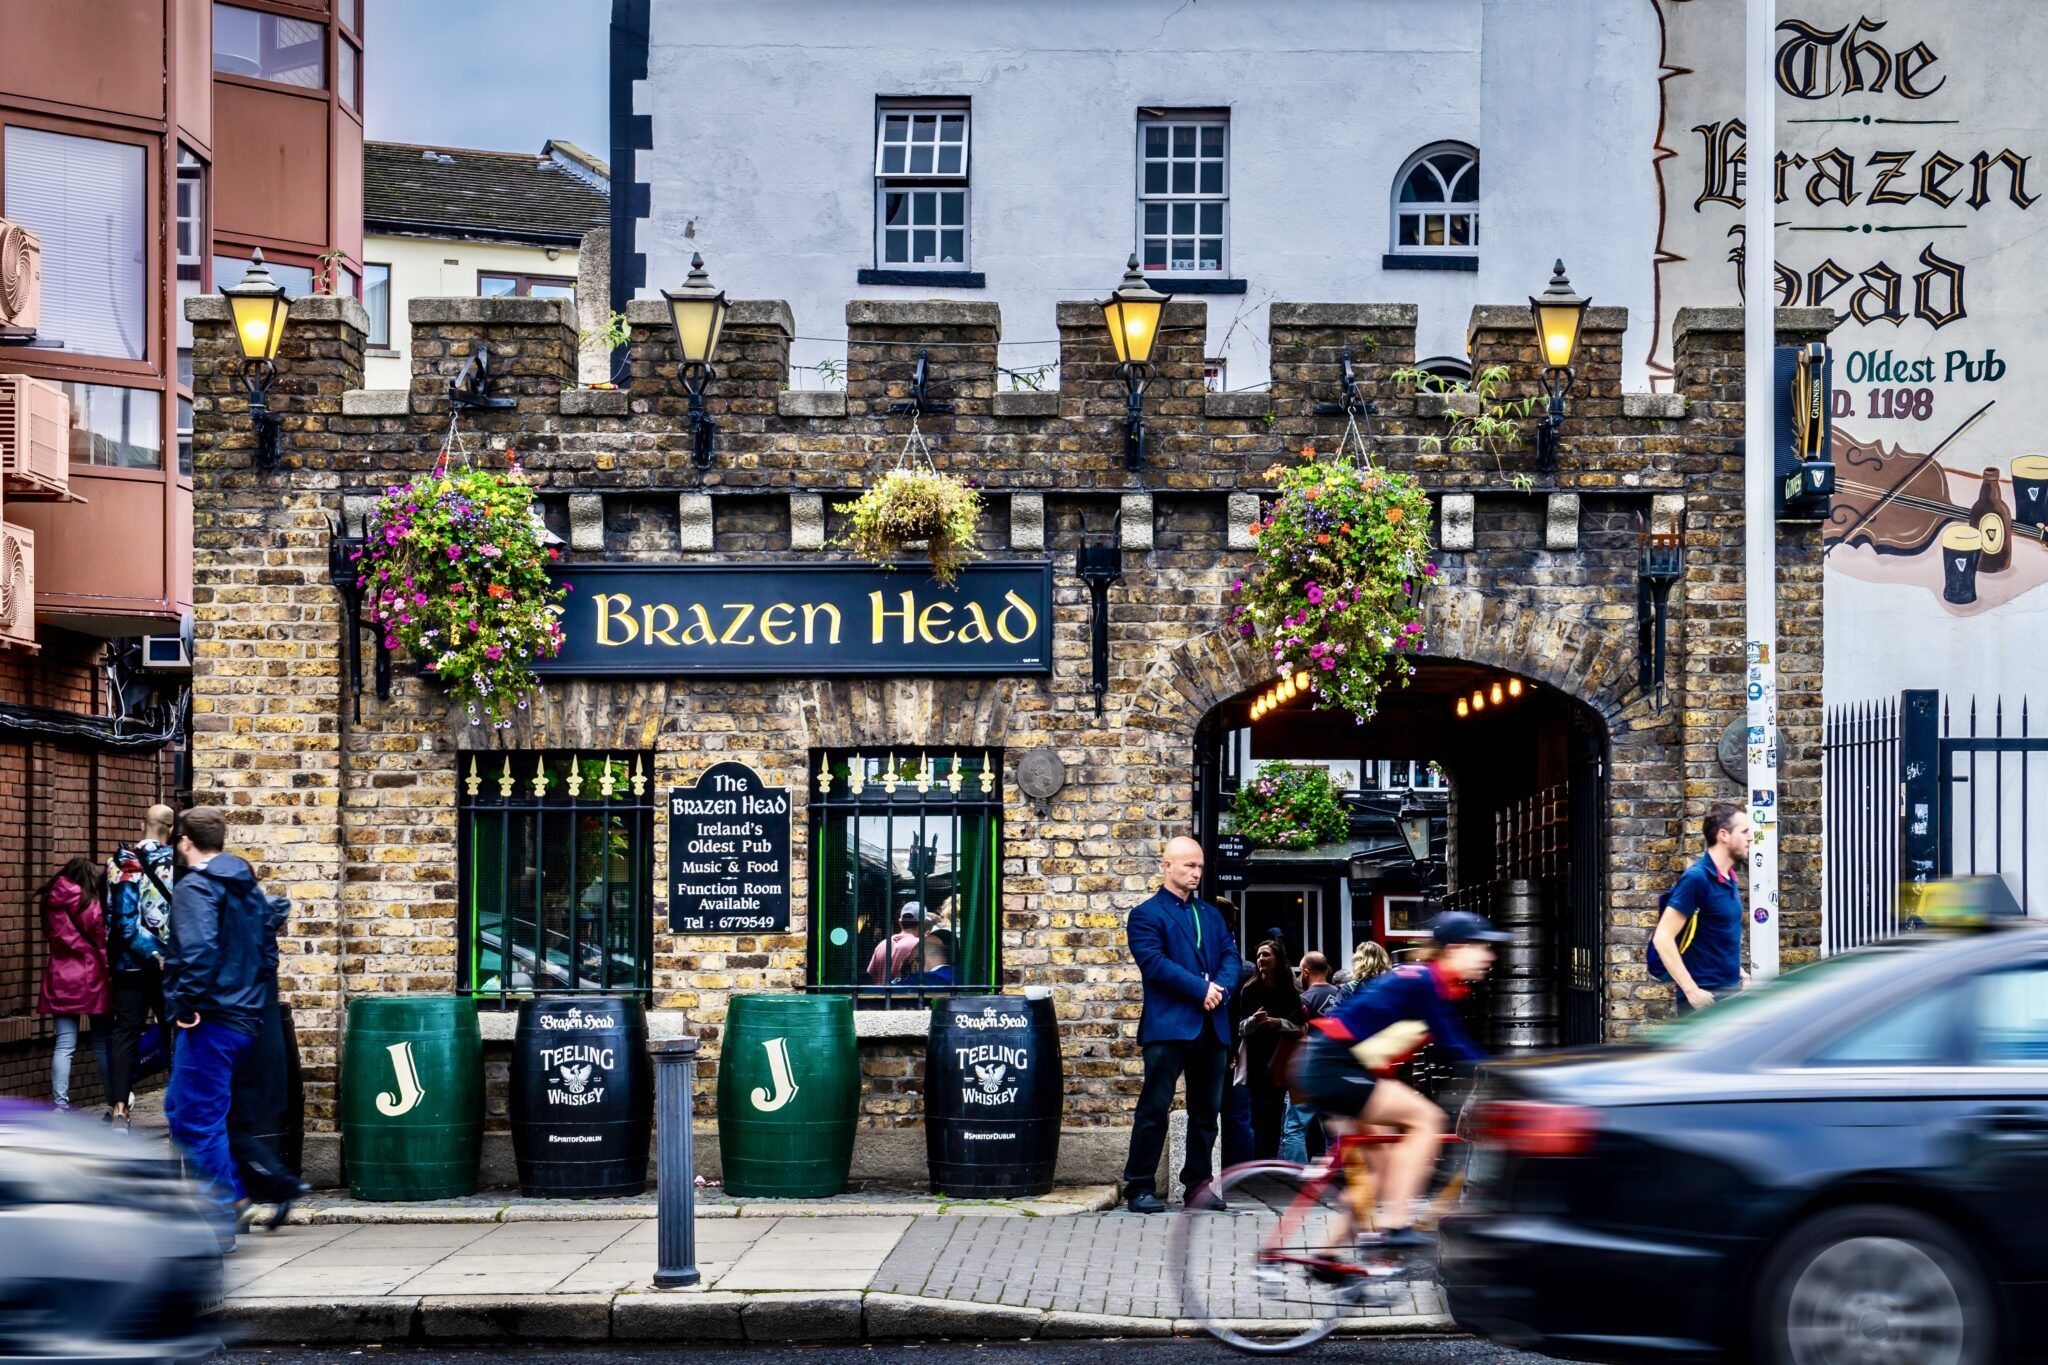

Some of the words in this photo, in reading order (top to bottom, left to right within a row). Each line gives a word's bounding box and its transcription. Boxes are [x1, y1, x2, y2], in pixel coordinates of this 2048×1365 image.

[1775, 15, 1947, 100] The
[1846, 349, 1936, 384] Oldest
[1944, 348, 2006, 383] Pub
[1811, 379, 1820, 419] GUINNESS
[1867, 387, 1934, 421] 1198
[713, 775, 748, 792] The
[697, 822, 763, 836] Ireland's
[687, 840, 735, 854] Oldest
[742, 840, 772, 853] Pub
[682, 861, 722, 873] Music
[728, 861, 740, 873] &
[747, 860, 779, 873] Food
[678, 883, 738, 895] Function
[744, 883, 782, 895] Room
[698, 898, 760, 910] Available
[719, 916, 774, 928] 6779549
[540, 1015, 582, 1031] Brazen
[583, 1014, 614, 1030] Head
[955, 1014, 998, 1031] Brazen
[998, 1013, 1028, 1030] Head
[540, 1045, 614, 1071] TEELING
[956, 1045, 1028, 1070] TEELING
[375, 1041, 426, 1117] J
[750, 1036, 800, 1112] J
